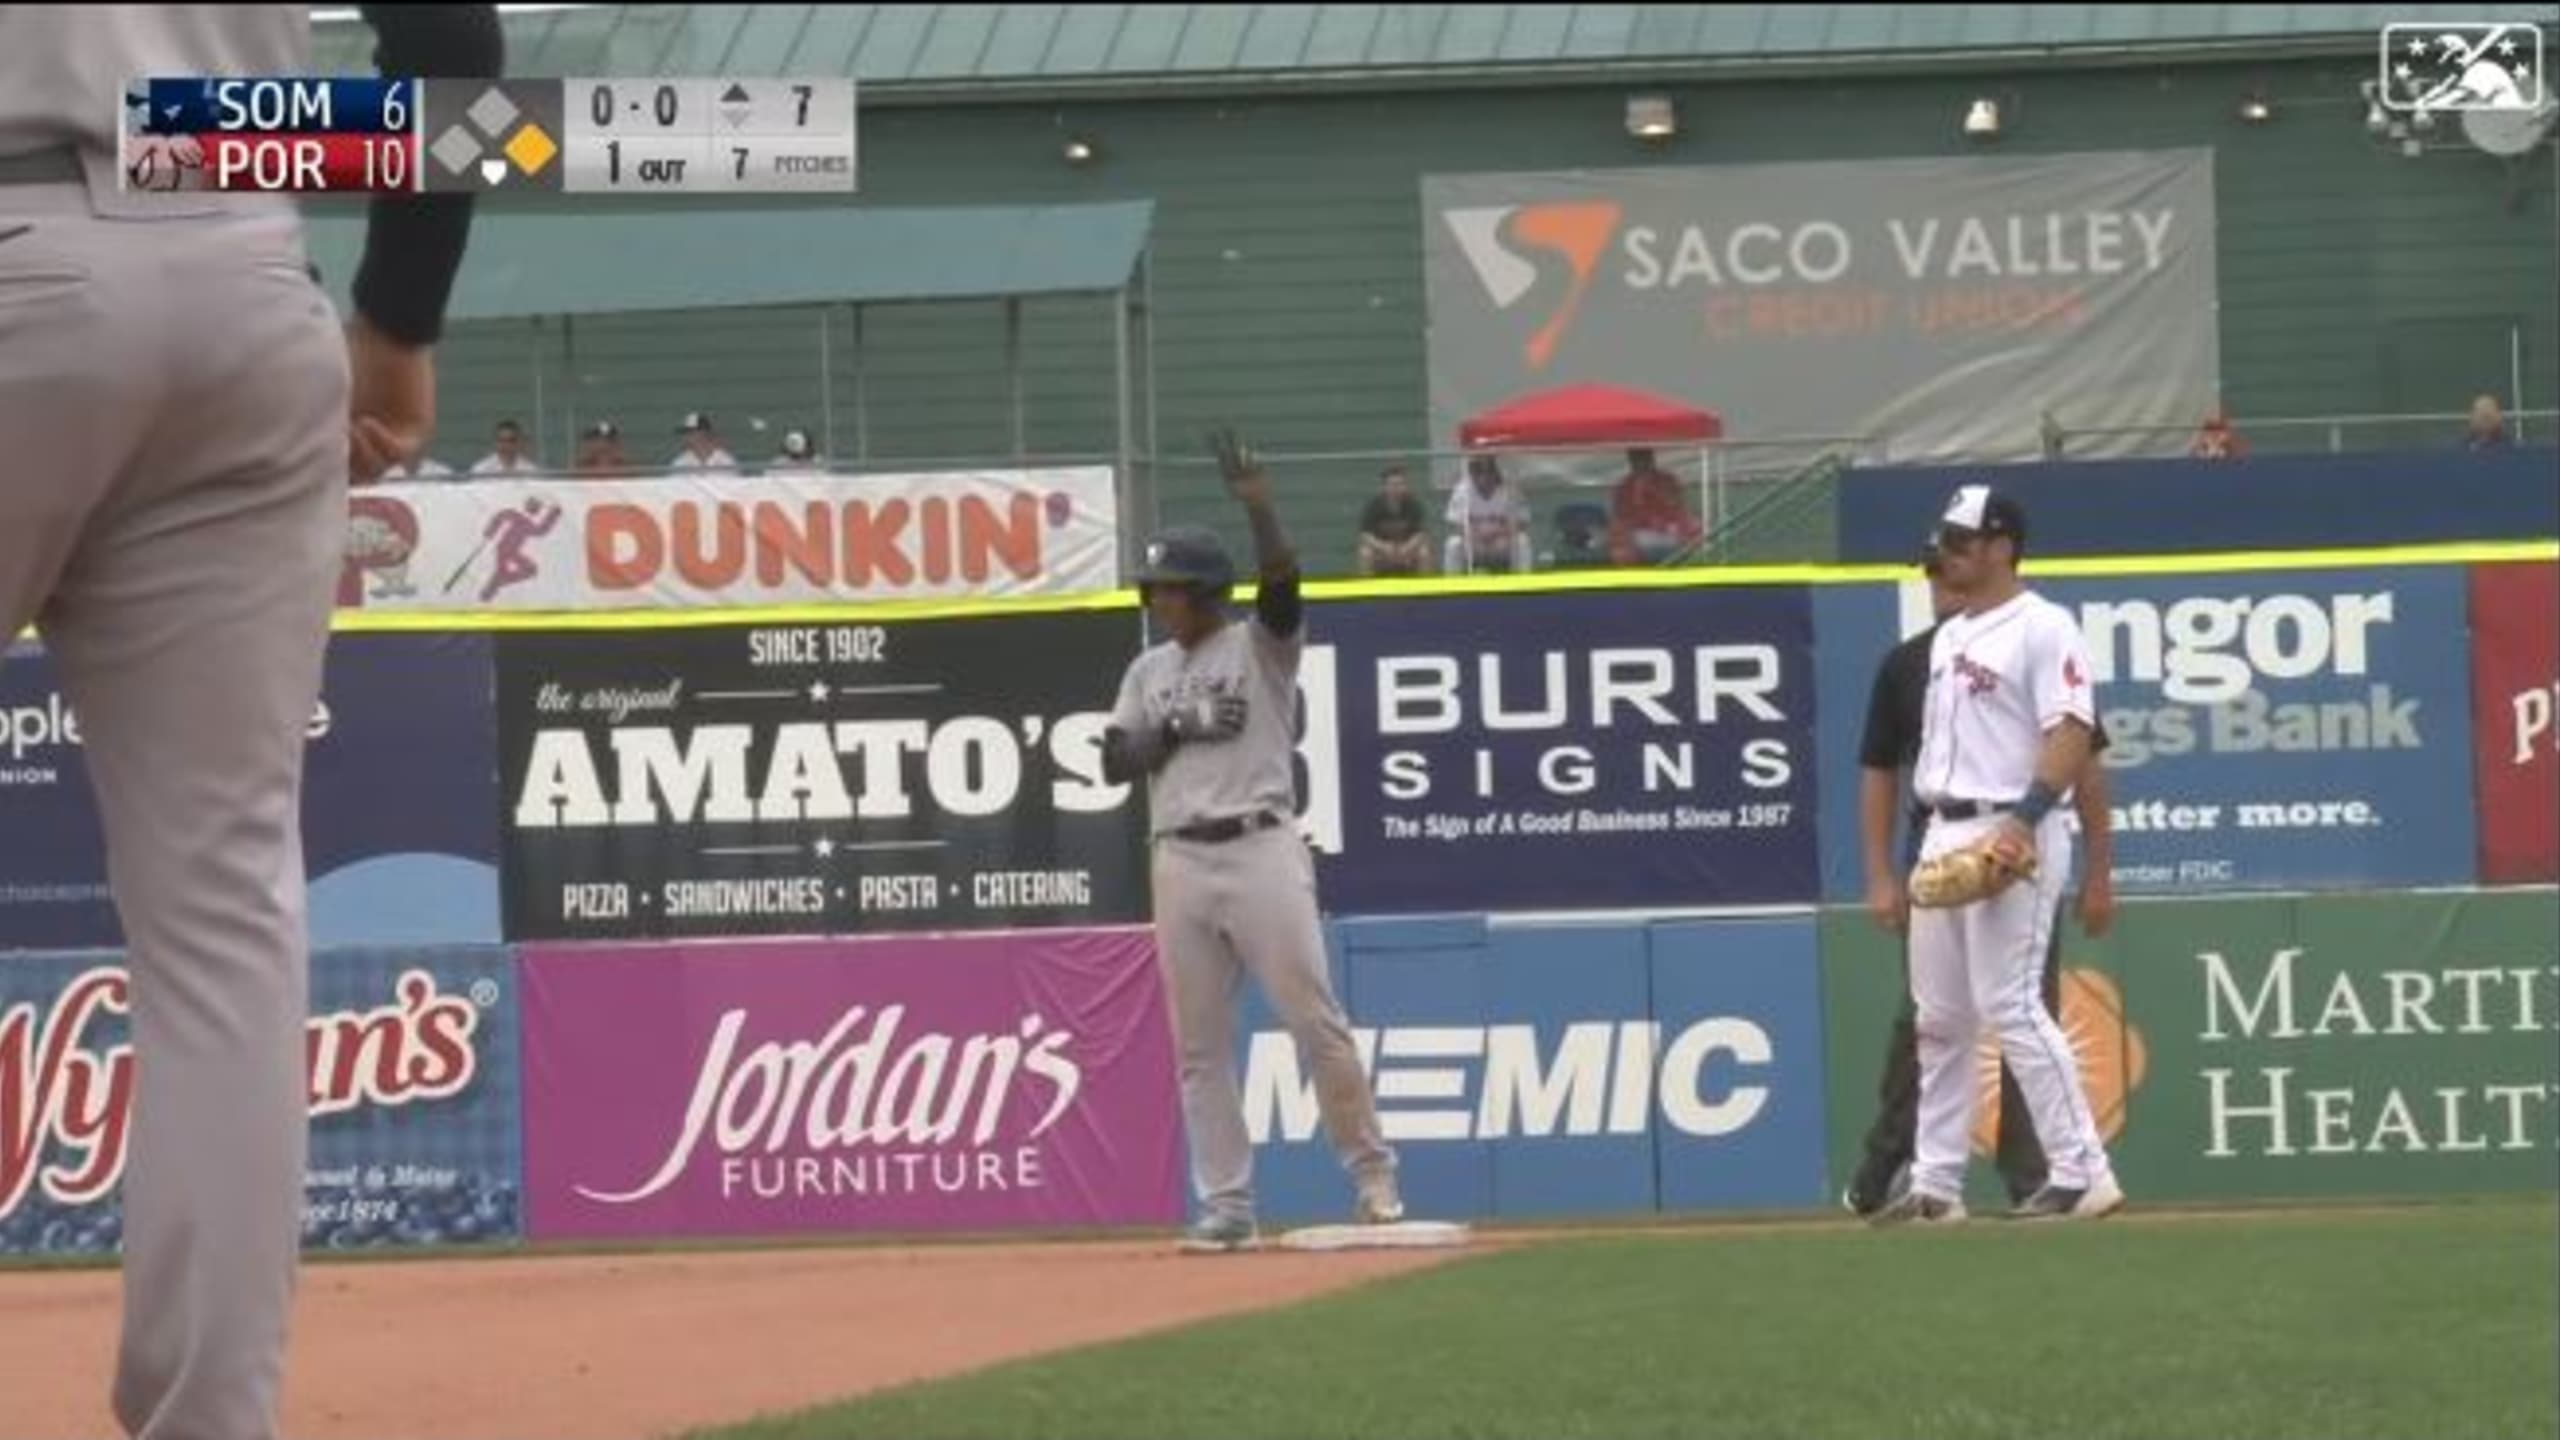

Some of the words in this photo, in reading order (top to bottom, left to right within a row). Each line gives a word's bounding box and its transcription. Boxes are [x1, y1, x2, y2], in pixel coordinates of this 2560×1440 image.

[1623, 219, 1852, 289] SACO
[1886, 207, 2175, 280] VALLEY
[1706, 290, 1889, 340] CREDIT
[1909, 284, 2094, 338] UNION
[584, 491, 1072, 592] DUNKIN'
[749, 627, 820, 665] SINCE
[825, 625, 887, 662] 1902
[535, 682, 574, 712] the
[580, 676, 684, 723] original
[1376, 644, 1788, 735] BURR
[2210, 682, 2424, 753] Bank
[515, 716, 1132, 827] AMATO'S
[1380, 737, 1793, 800] SIGNS
[1383, 815, 1419, 839] The
[1425, 812, 1470, 841] Sign
[1475, 810, 1496, 836] of
[1499, 812, 1515, 834] A
[1518, 810, 1574, 833] Good
[1577, 808, 1670, 832] Business
[1674, 806, 1732, 829] Since
[1737, 803, 1793, 828] 1987
[2109, 798, 2222, 832] atter
[2236, 799, 2383, 829] more.
[563, 883, 629, 919] PIZZA
[664, 878, 825, 916] SANDWICHES
[859, 874, 938, 909] PASTA
[972, 870, 1091, 909] CATERING
[2109, 864, 2175, 882] ember
[2178, 859, 2234, 881] FDIC
[2197, 946, 2560, 1041] MARTI
[571, 1003, 1081, 1202] Jordan's
[1242, 1016, 1775, 1144] MEMIC
[2200, 1065, 2560, 1158] HEALT
[721, 1146, 1045, 1198] FURNITURE
